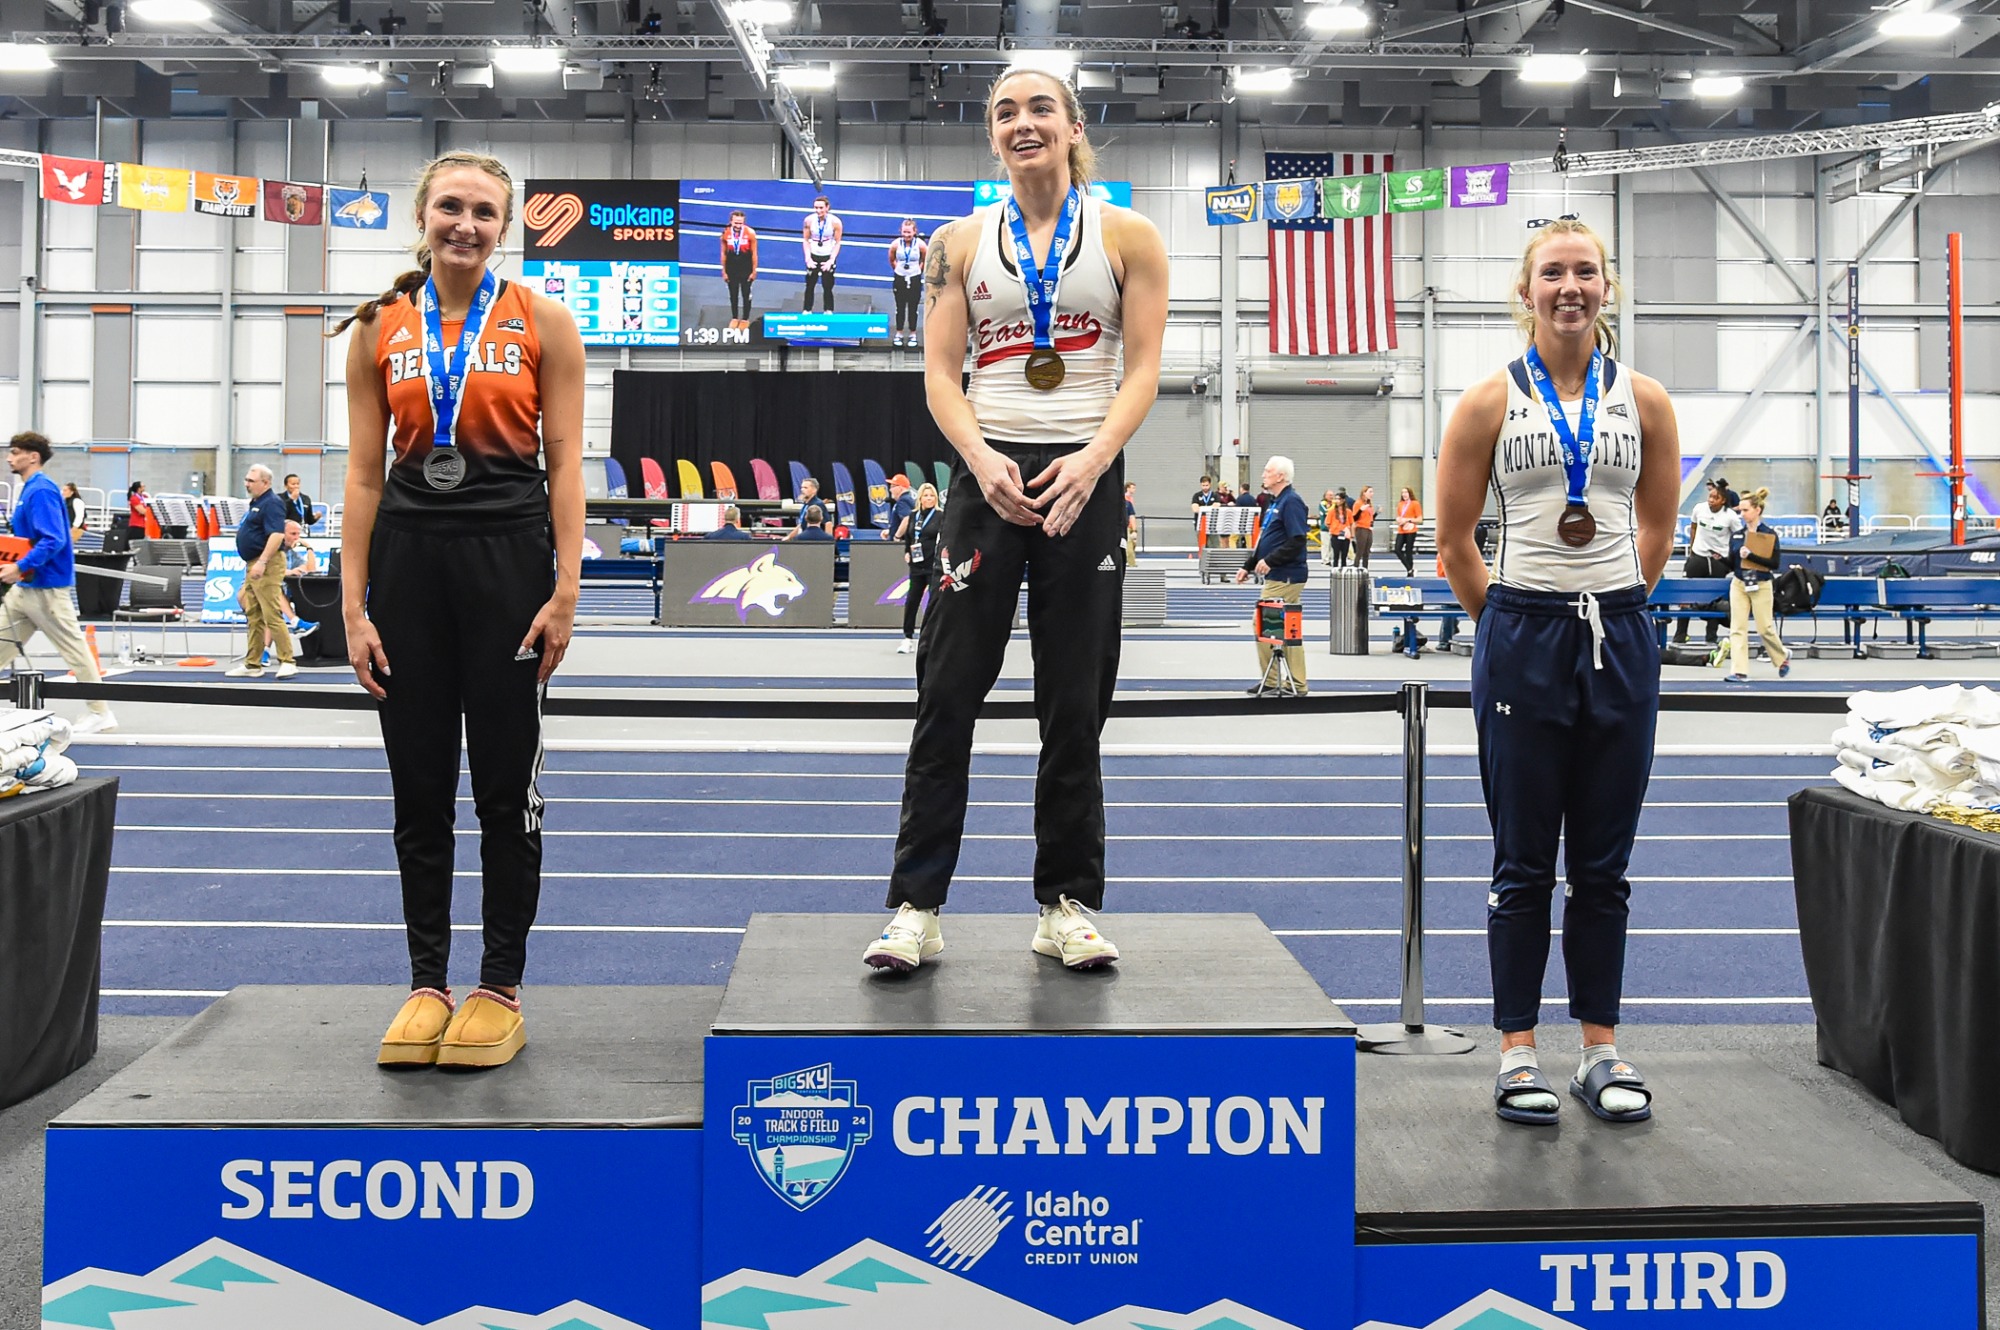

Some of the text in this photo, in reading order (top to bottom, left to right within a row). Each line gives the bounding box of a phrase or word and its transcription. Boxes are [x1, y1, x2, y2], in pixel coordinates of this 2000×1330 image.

[226, 204, 250, 216] STATE
[1212, 194, 1250, 210] NAU
[590, 203, 674, 231] Spokane
[613, 228, 675, 241] SPORTS
[972, 293, 992, 301] adidas
[684, 327, 749, 344] 1:39 PM
[388, 342, 523, 386] BEALS
[1503, 432, 1576, 474] MONTA
[1970, 551, 1996, 562] GILL
[775, 1067, 828, 1090] BIGSKY
[737, 1116, 866, 1126] 20 24
[781, 1109, 824, 1119] INDOOR
[764, 1119, 840, 1133] TRACK & FIELD
[892, 1096, 1325, 1157] CHAMPION
[766, 1135, 837, 1144] CHAMPIONSHIP
[221, 1159, 535, 1220] SECOND
[1025, 1190, 1110, 1217] Idaho
[1024, 1219, 1139, 1246] Central
[1025, 1253, 1138, 1265] CREDIT UNION
[1540, 1251, 1787, 1312] THIRD
